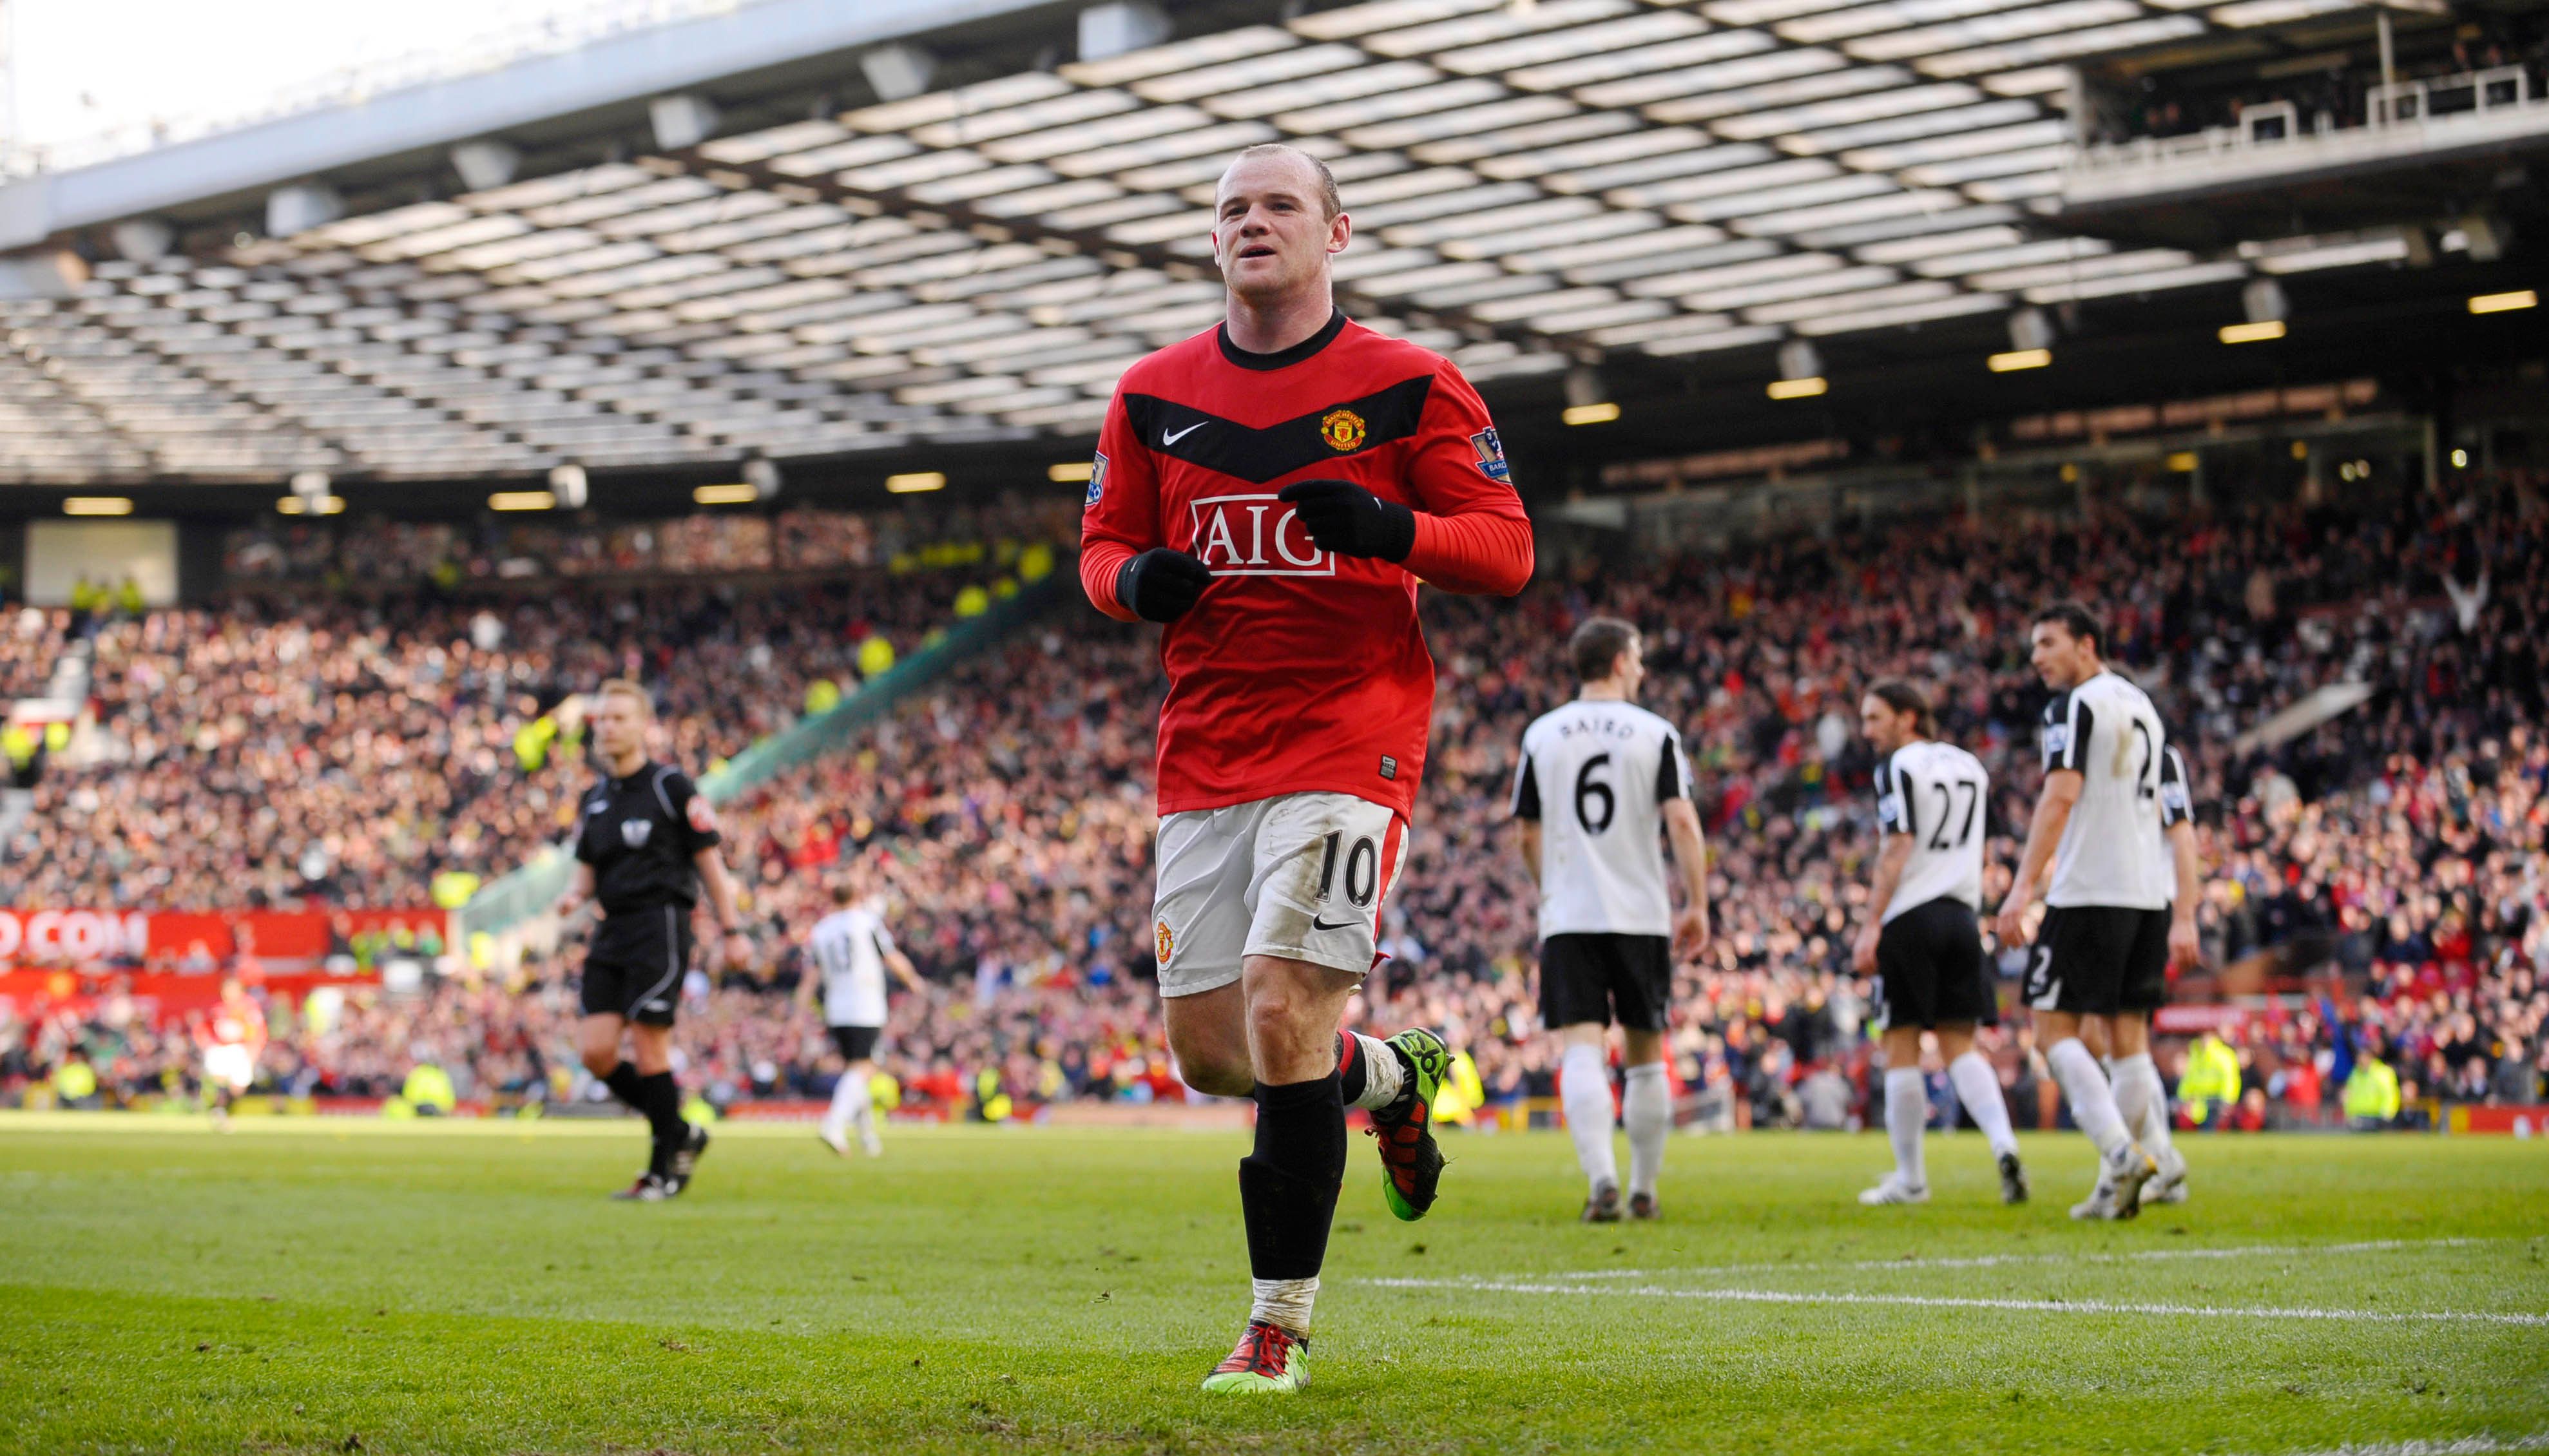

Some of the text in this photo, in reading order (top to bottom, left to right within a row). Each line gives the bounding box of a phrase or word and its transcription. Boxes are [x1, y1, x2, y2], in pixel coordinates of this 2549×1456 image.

[1331, 439, 1356, 448] UNITED
[1203, 506, 1322, 566] AIG
[1560, 717, 1635, 739] BAIRD
[2132, 716, 2154, 800] 2
[1575, 753, 1615, 836] 6
[1929, 780, 1977, 850] 27
[1312, 829, 1378, 910] 10
[2031, 945, 2052, 985] 2
